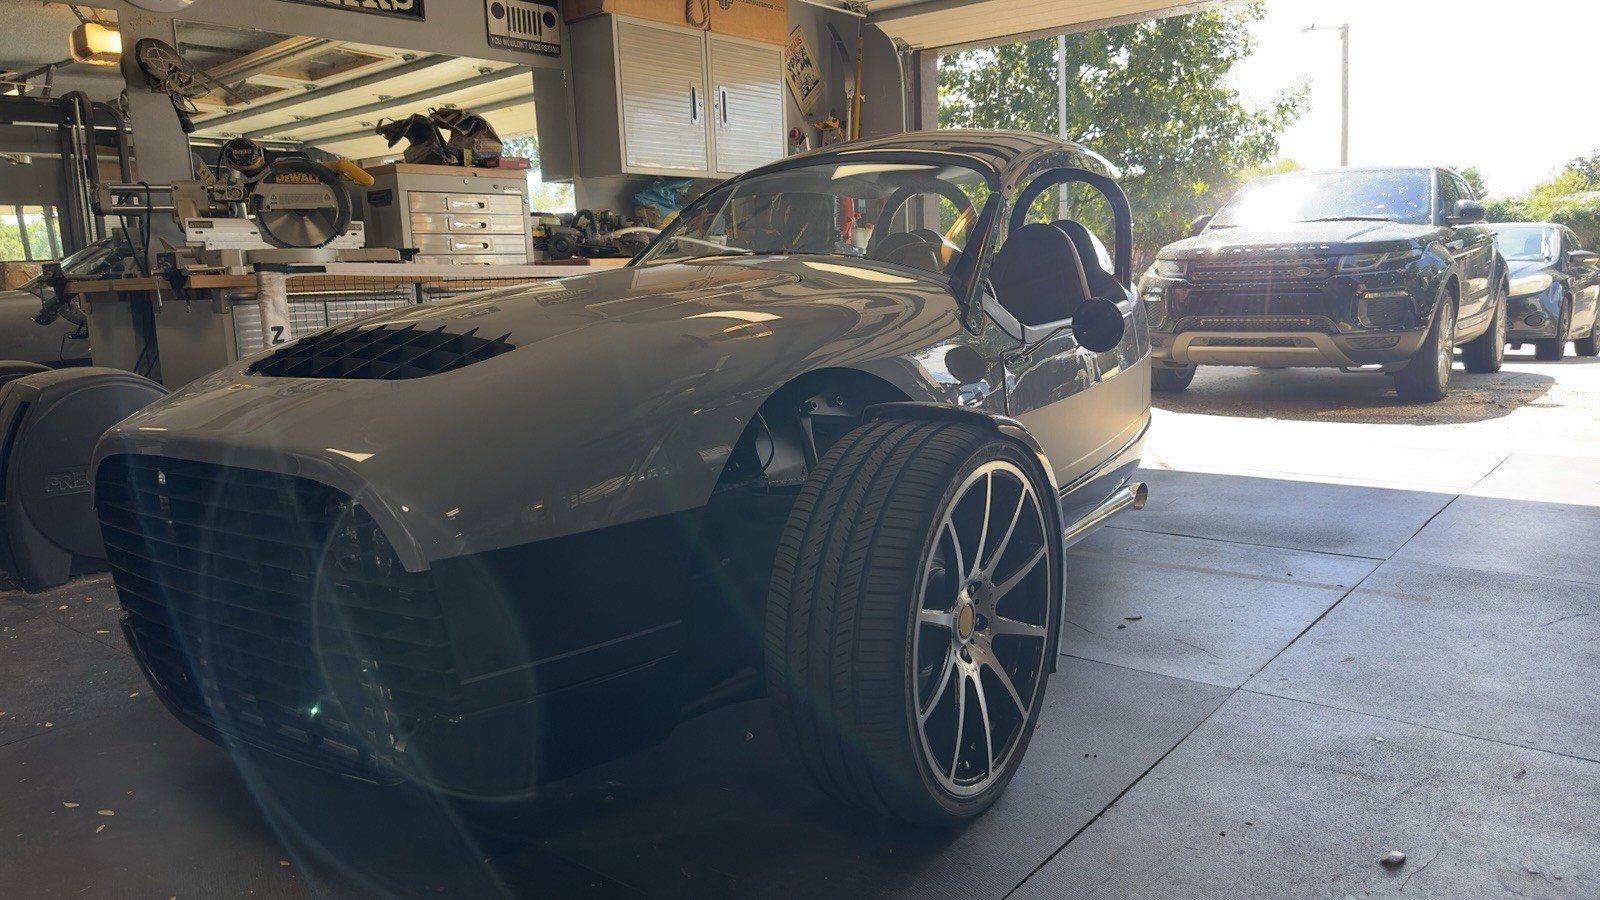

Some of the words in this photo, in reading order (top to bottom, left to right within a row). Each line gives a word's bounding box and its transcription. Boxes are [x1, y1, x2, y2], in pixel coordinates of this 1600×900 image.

[490, 36, 502, 45] YOU
[528, 41, 560, 53] UNDERSTAND
[270, 325, 285, 344] Z
